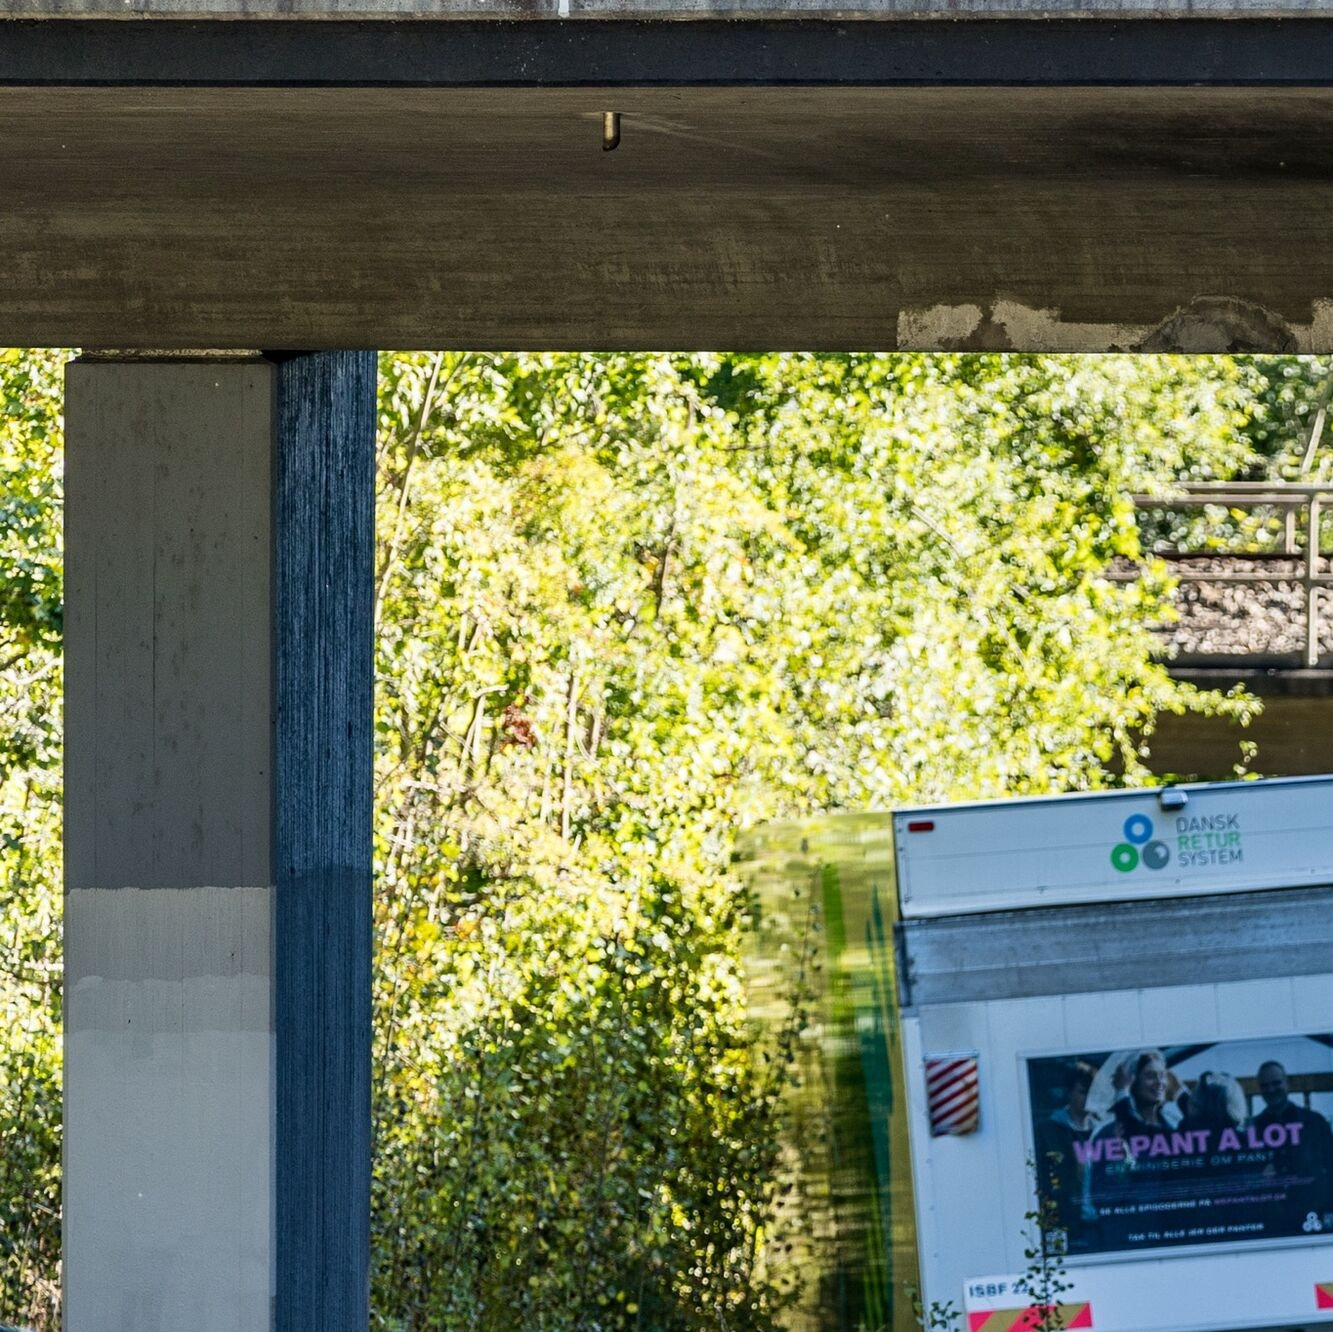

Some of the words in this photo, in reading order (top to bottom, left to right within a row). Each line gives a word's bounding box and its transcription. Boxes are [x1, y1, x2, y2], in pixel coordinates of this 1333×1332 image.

[1176, 813, 1240, 833] DANSK
[1177, 832, 1240, 850] RETUR
[1178, 849, 1242, 867] SYSTEM
[1073, 1138, 1124, 1164] WE
[1130, 1129, 1211, 1158] PANT
[1218, 1127, 1241, 1151] A
[1247, 1122, 1303, 1149] LOT
[1211, 1154, 1233, 1167] OM
[1238, 1151, 1275, 1164] PANT
